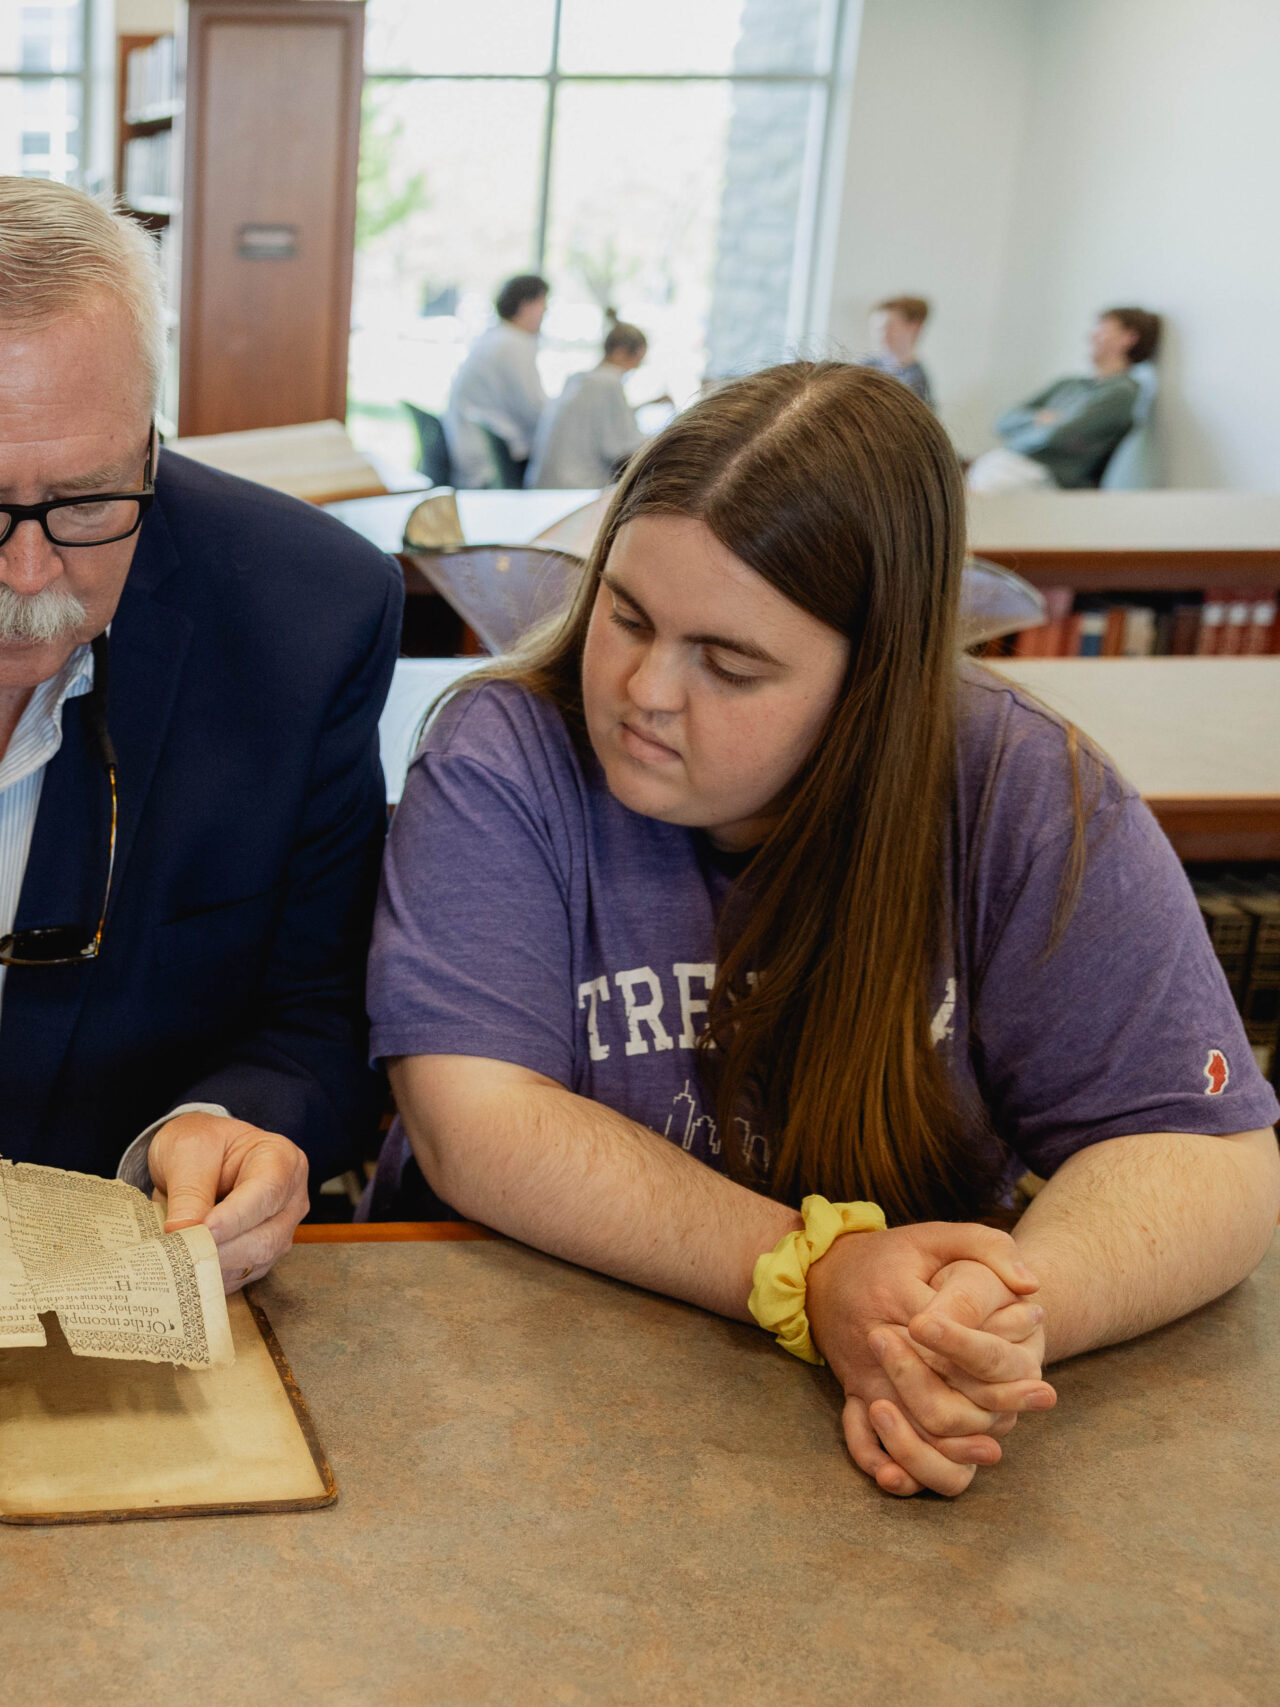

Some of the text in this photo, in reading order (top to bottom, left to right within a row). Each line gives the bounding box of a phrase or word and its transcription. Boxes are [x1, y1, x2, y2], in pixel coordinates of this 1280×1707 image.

[55, 1295, 64, 1303] of
[108, 1303, 131, 1315] holy
[123, 1318, 144, 1331] the
[144, 1320, 166, 1334] Of
